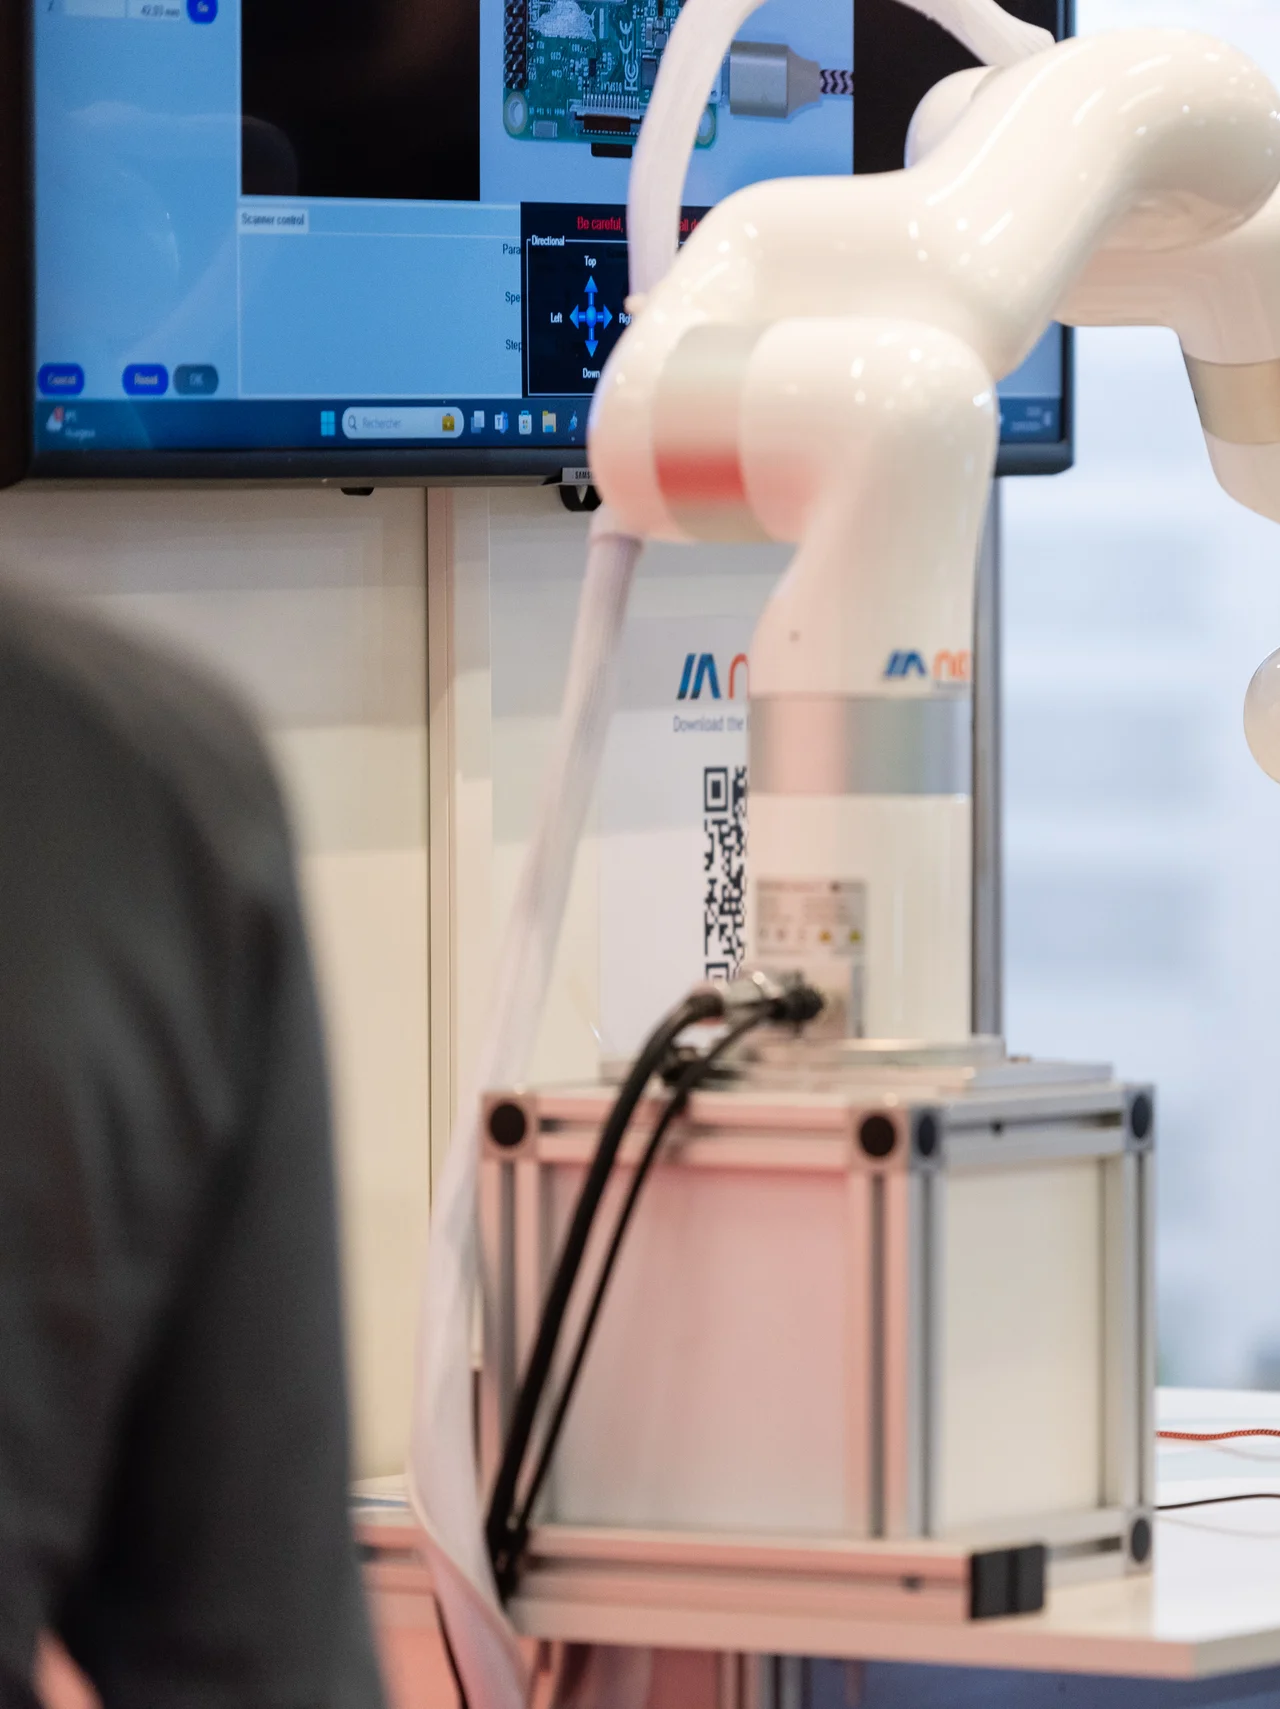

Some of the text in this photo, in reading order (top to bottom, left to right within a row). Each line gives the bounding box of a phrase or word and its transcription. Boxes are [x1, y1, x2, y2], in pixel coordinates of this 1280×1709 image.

[242, 212, 304, 225] Scanner control
[577, 216, 590, 230] Be
[591, 216, 624, 233] careful,
[531, 235, 565, 246] Directional
[584, 255, 596, 268] Top
[550, 312, 563, 323] Left
[582, 367, 600, 378] Down
[673, 715, 743, 732] Download the
